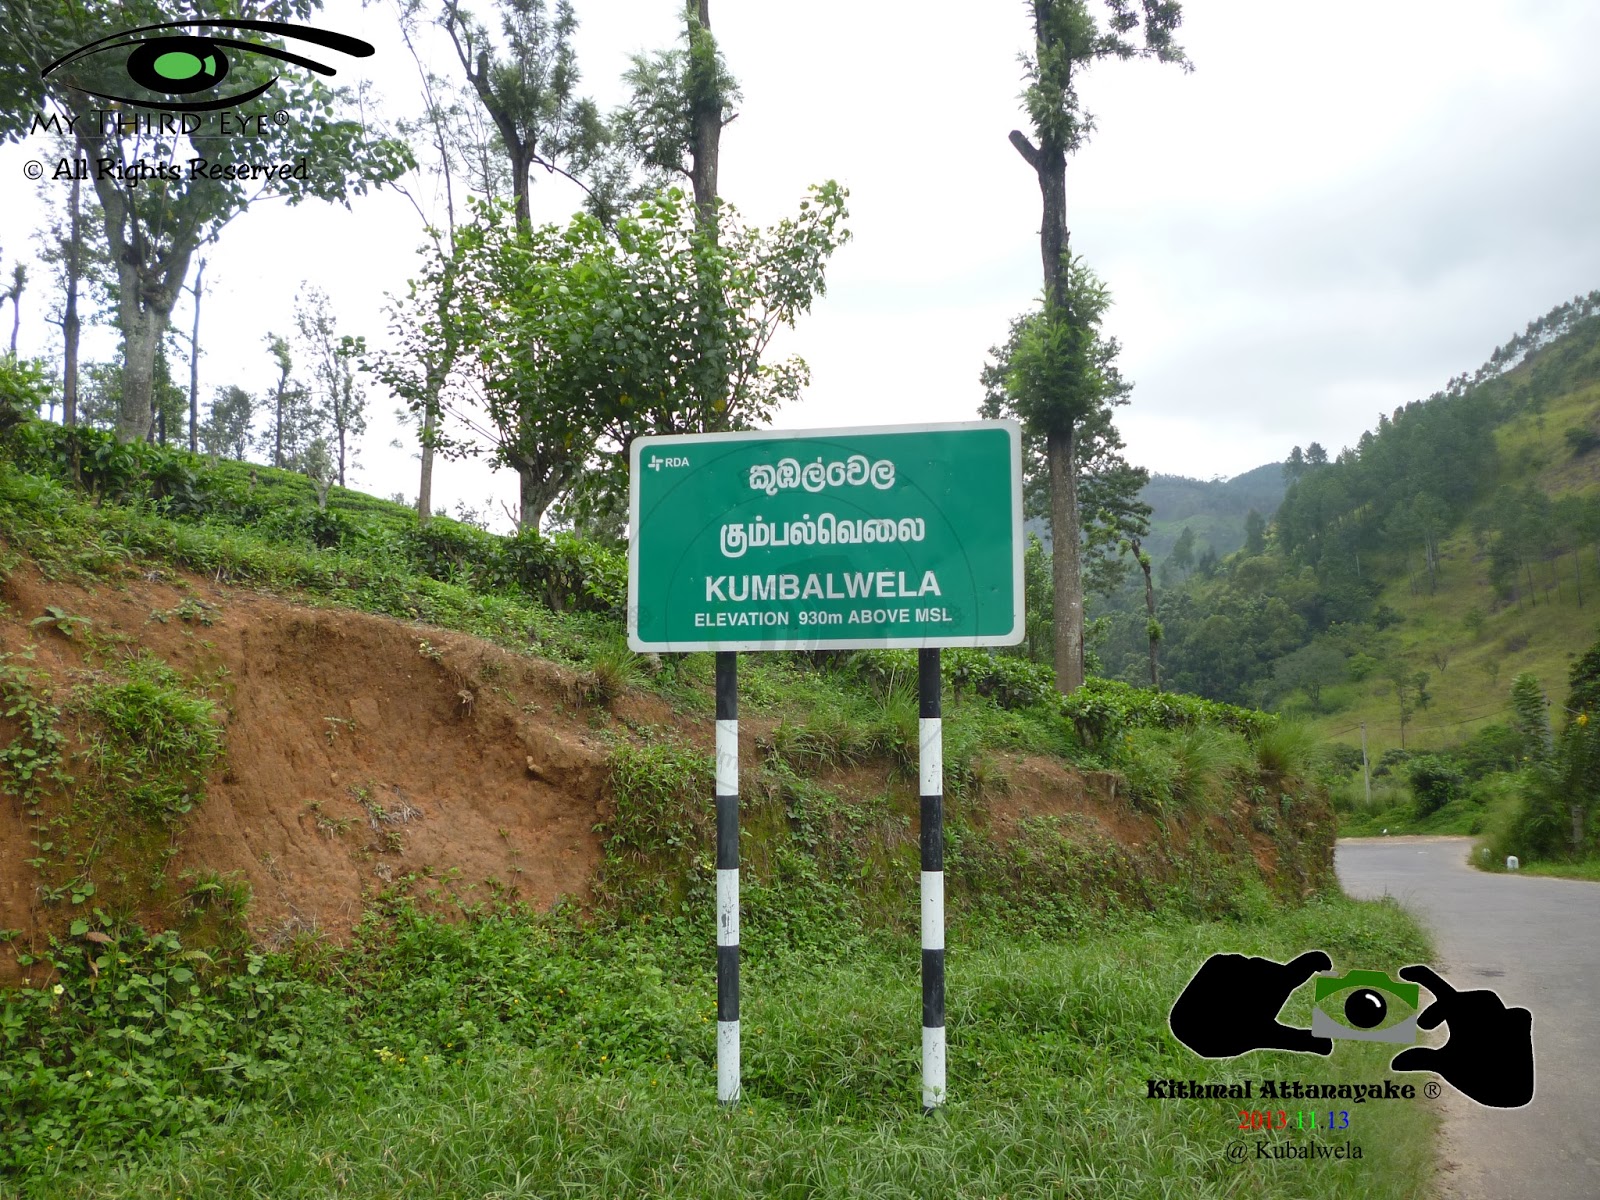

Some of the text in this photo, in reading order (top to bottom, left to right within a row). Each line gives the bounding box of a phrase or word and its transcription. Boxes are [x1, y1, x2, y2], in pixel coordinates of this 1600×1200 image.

[665, 457, 690, 468] RDA
[749, 454, 896, 496] කුඹල්වෙල
[720, 512, 926, 558] கும்பல்வெலை
[705, 570, 942, 602] KUMBALWELA
[694, 607, 953, 627] ELEVATION 930m ABOVE MSL
